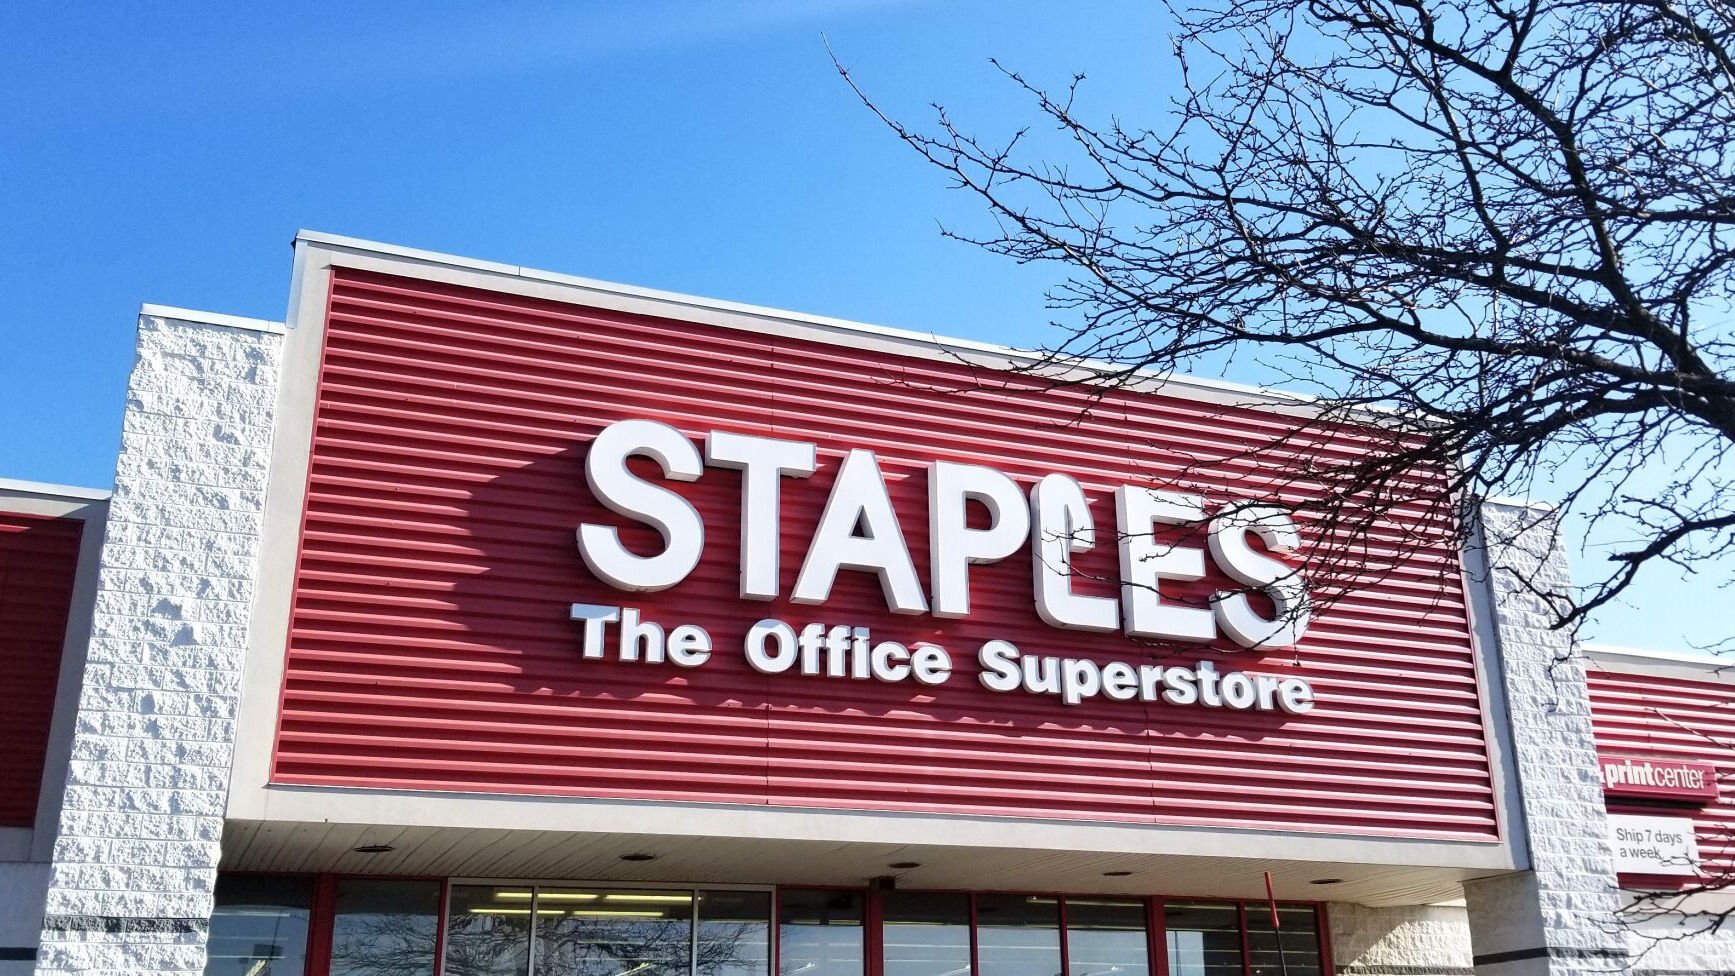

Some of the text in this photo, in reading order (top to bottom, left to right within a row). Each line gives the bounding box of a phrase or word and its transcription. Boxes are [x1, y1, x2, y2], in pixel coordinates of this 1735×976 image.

[576, 419, 1310, 650] STAPLES
[570, 603, 1315, 715] The Office Superstore
[1616, 827, 1683, 844] Ship 7 days
[1620, 847, 1661, 859] a week
